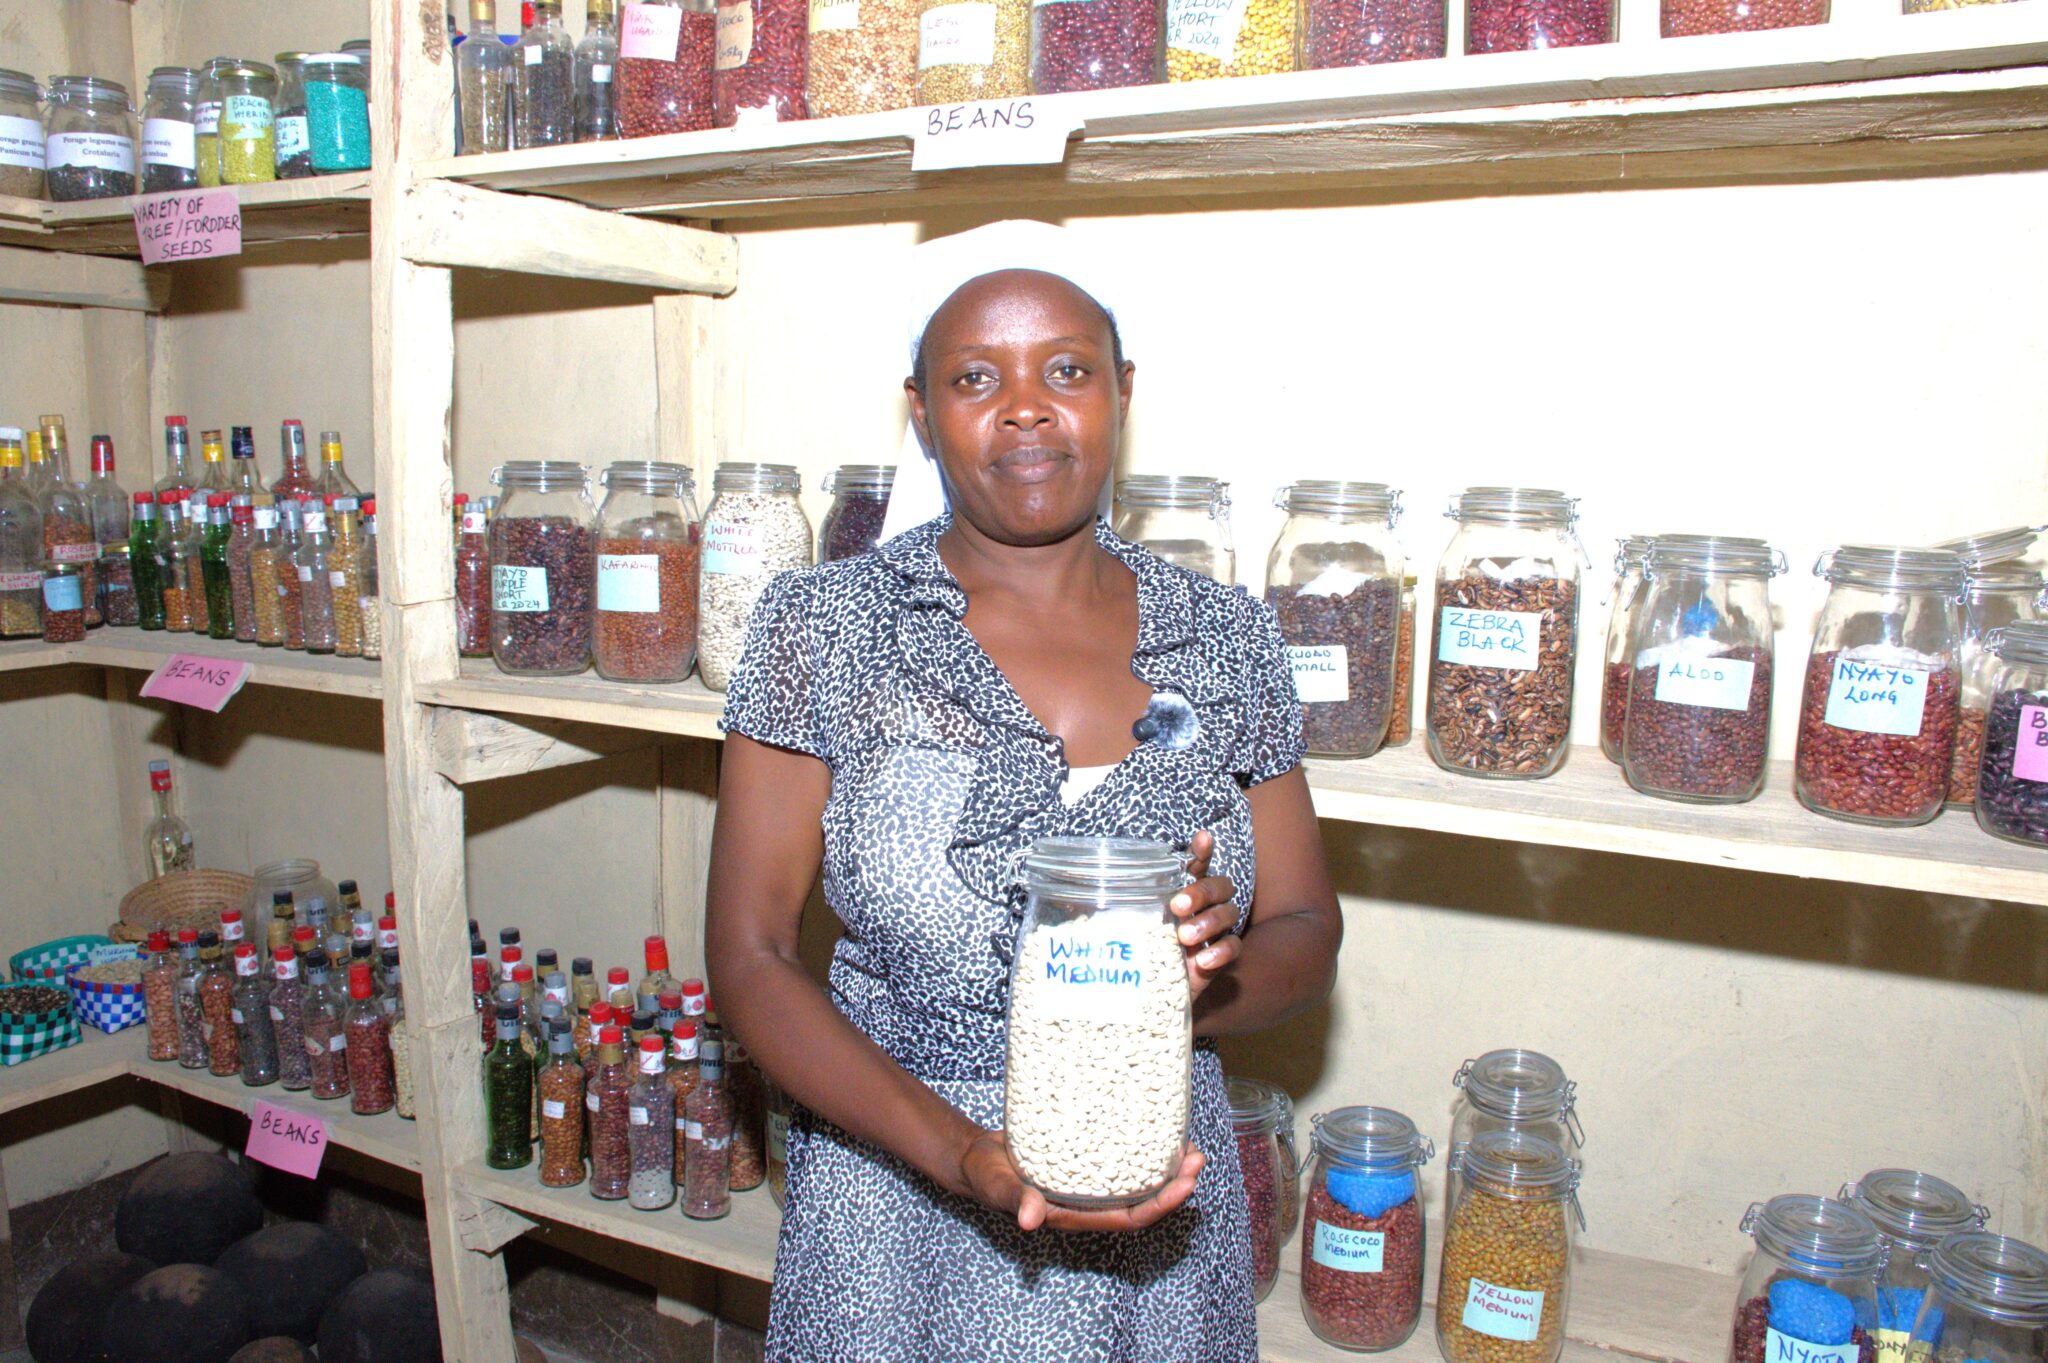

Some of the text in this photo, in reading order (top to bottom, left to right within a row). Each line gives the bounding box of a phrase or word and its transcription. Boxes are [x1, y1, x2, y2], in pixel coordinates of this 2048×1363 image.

[1169, 12, 1224, 29] SHORT
[927, 102, 1034, 136] BEANS
[133, 196, 204, 225] VARIETY OF
[160, 238, 213, 260] SEEDS
[1449, 612, 1525, 639] ZEBRA
[1457, 630, 1527, 654] BLACK
[165, 660, 230, 687] BEANS
[1291, 662, 1337, 672] MALL
[1839, 662, 1914, 686] NYAYO
[1844, 686, 1898, 705] LONG
[1050, 936, 1134, 961] WHITE
[1046, 961, 1141, 989] MEDIUM
[260, 1110, 321, 1145] BEANS
[1324, 1241, 1370, 1259] MEDIUM
[1474, 1281, 1535, 1306] YELLOW
[1472, 1295, 1535, 1323] MEDIUM
